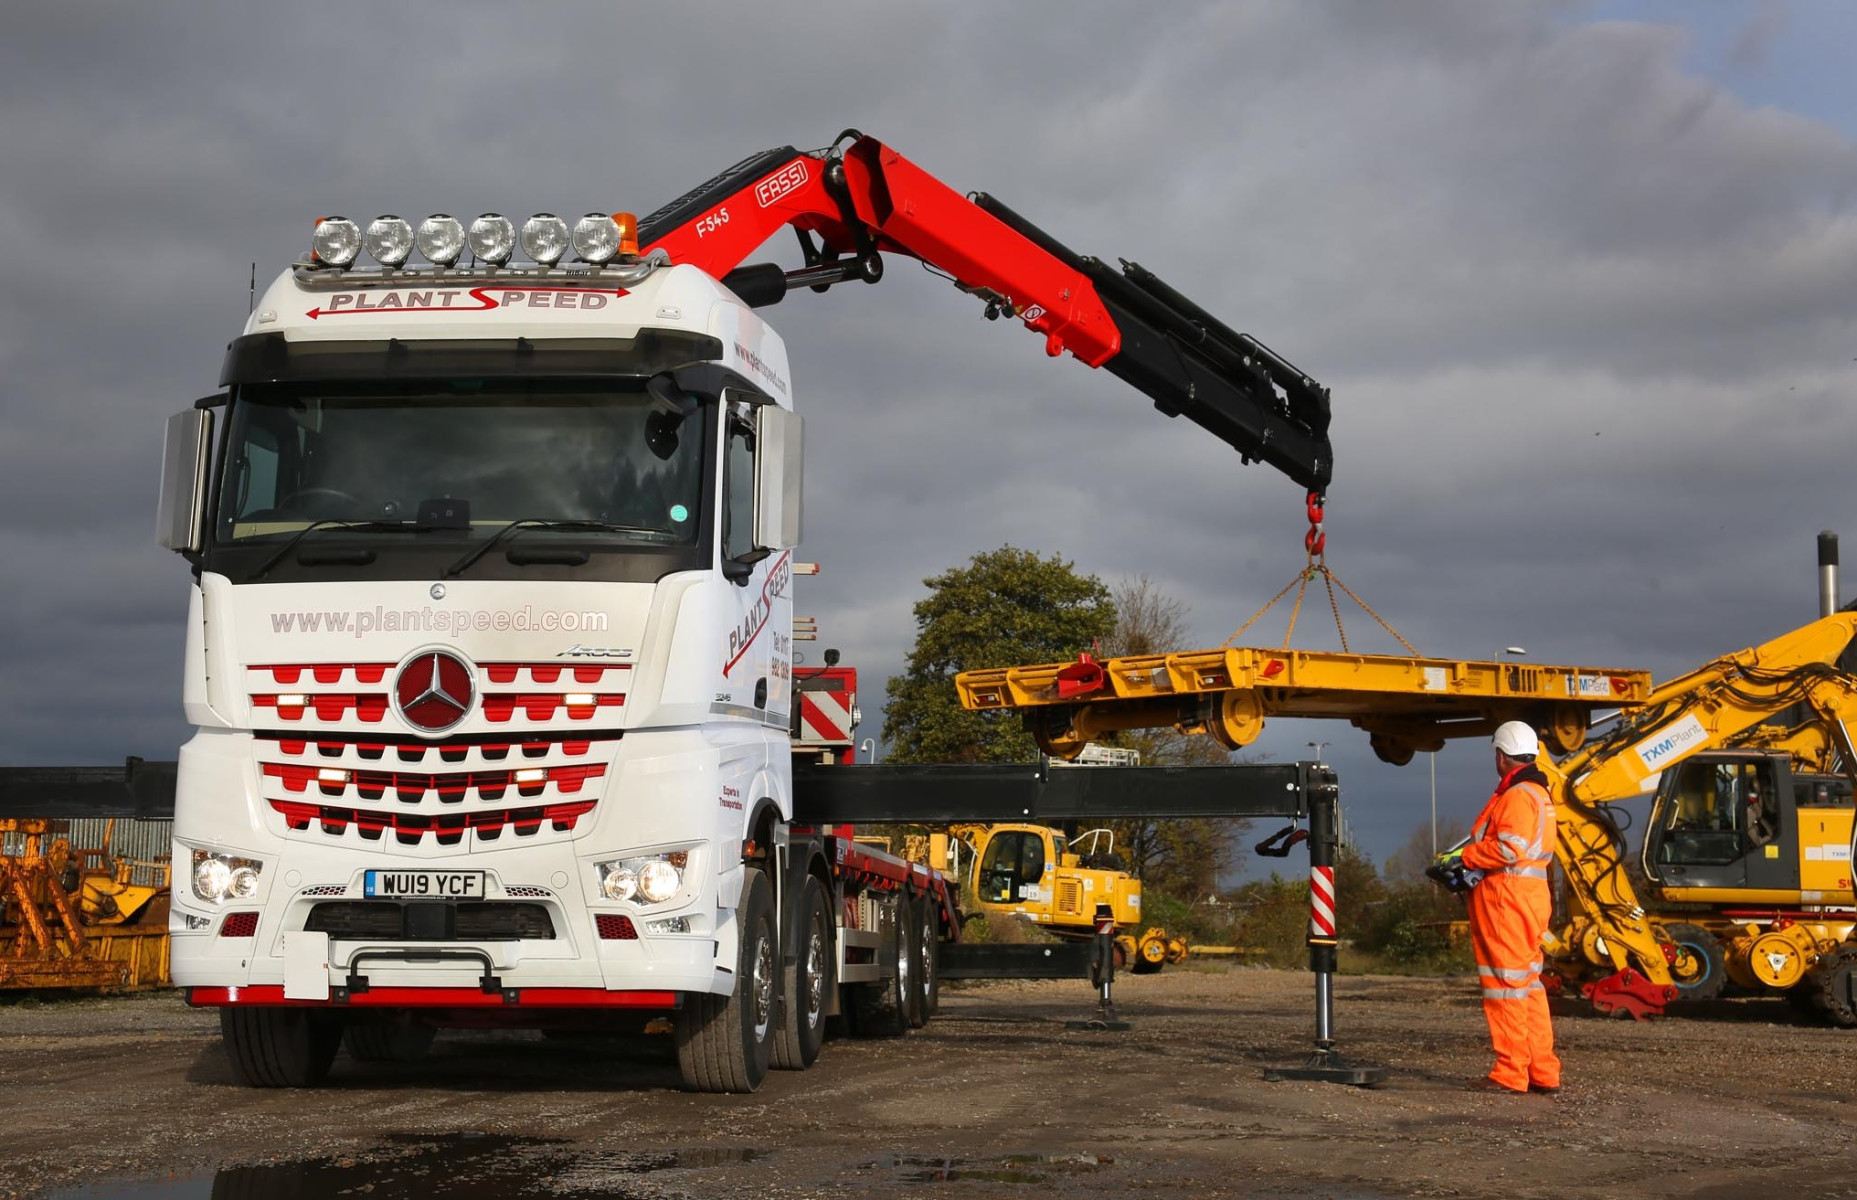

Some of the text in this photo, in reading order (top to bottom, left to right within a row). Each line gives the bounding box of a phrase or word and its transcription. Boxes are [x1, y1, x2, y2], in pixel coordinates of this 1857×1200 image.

[759, 164, 804, 203] FASSI
[696, 207, 730, 238] F545
[271, 605, 609, 638] www.plantspeed.com
[1642, 724, 1702, 762] TXMPlant
[383, 873, 476, 895] WU19 YCF
